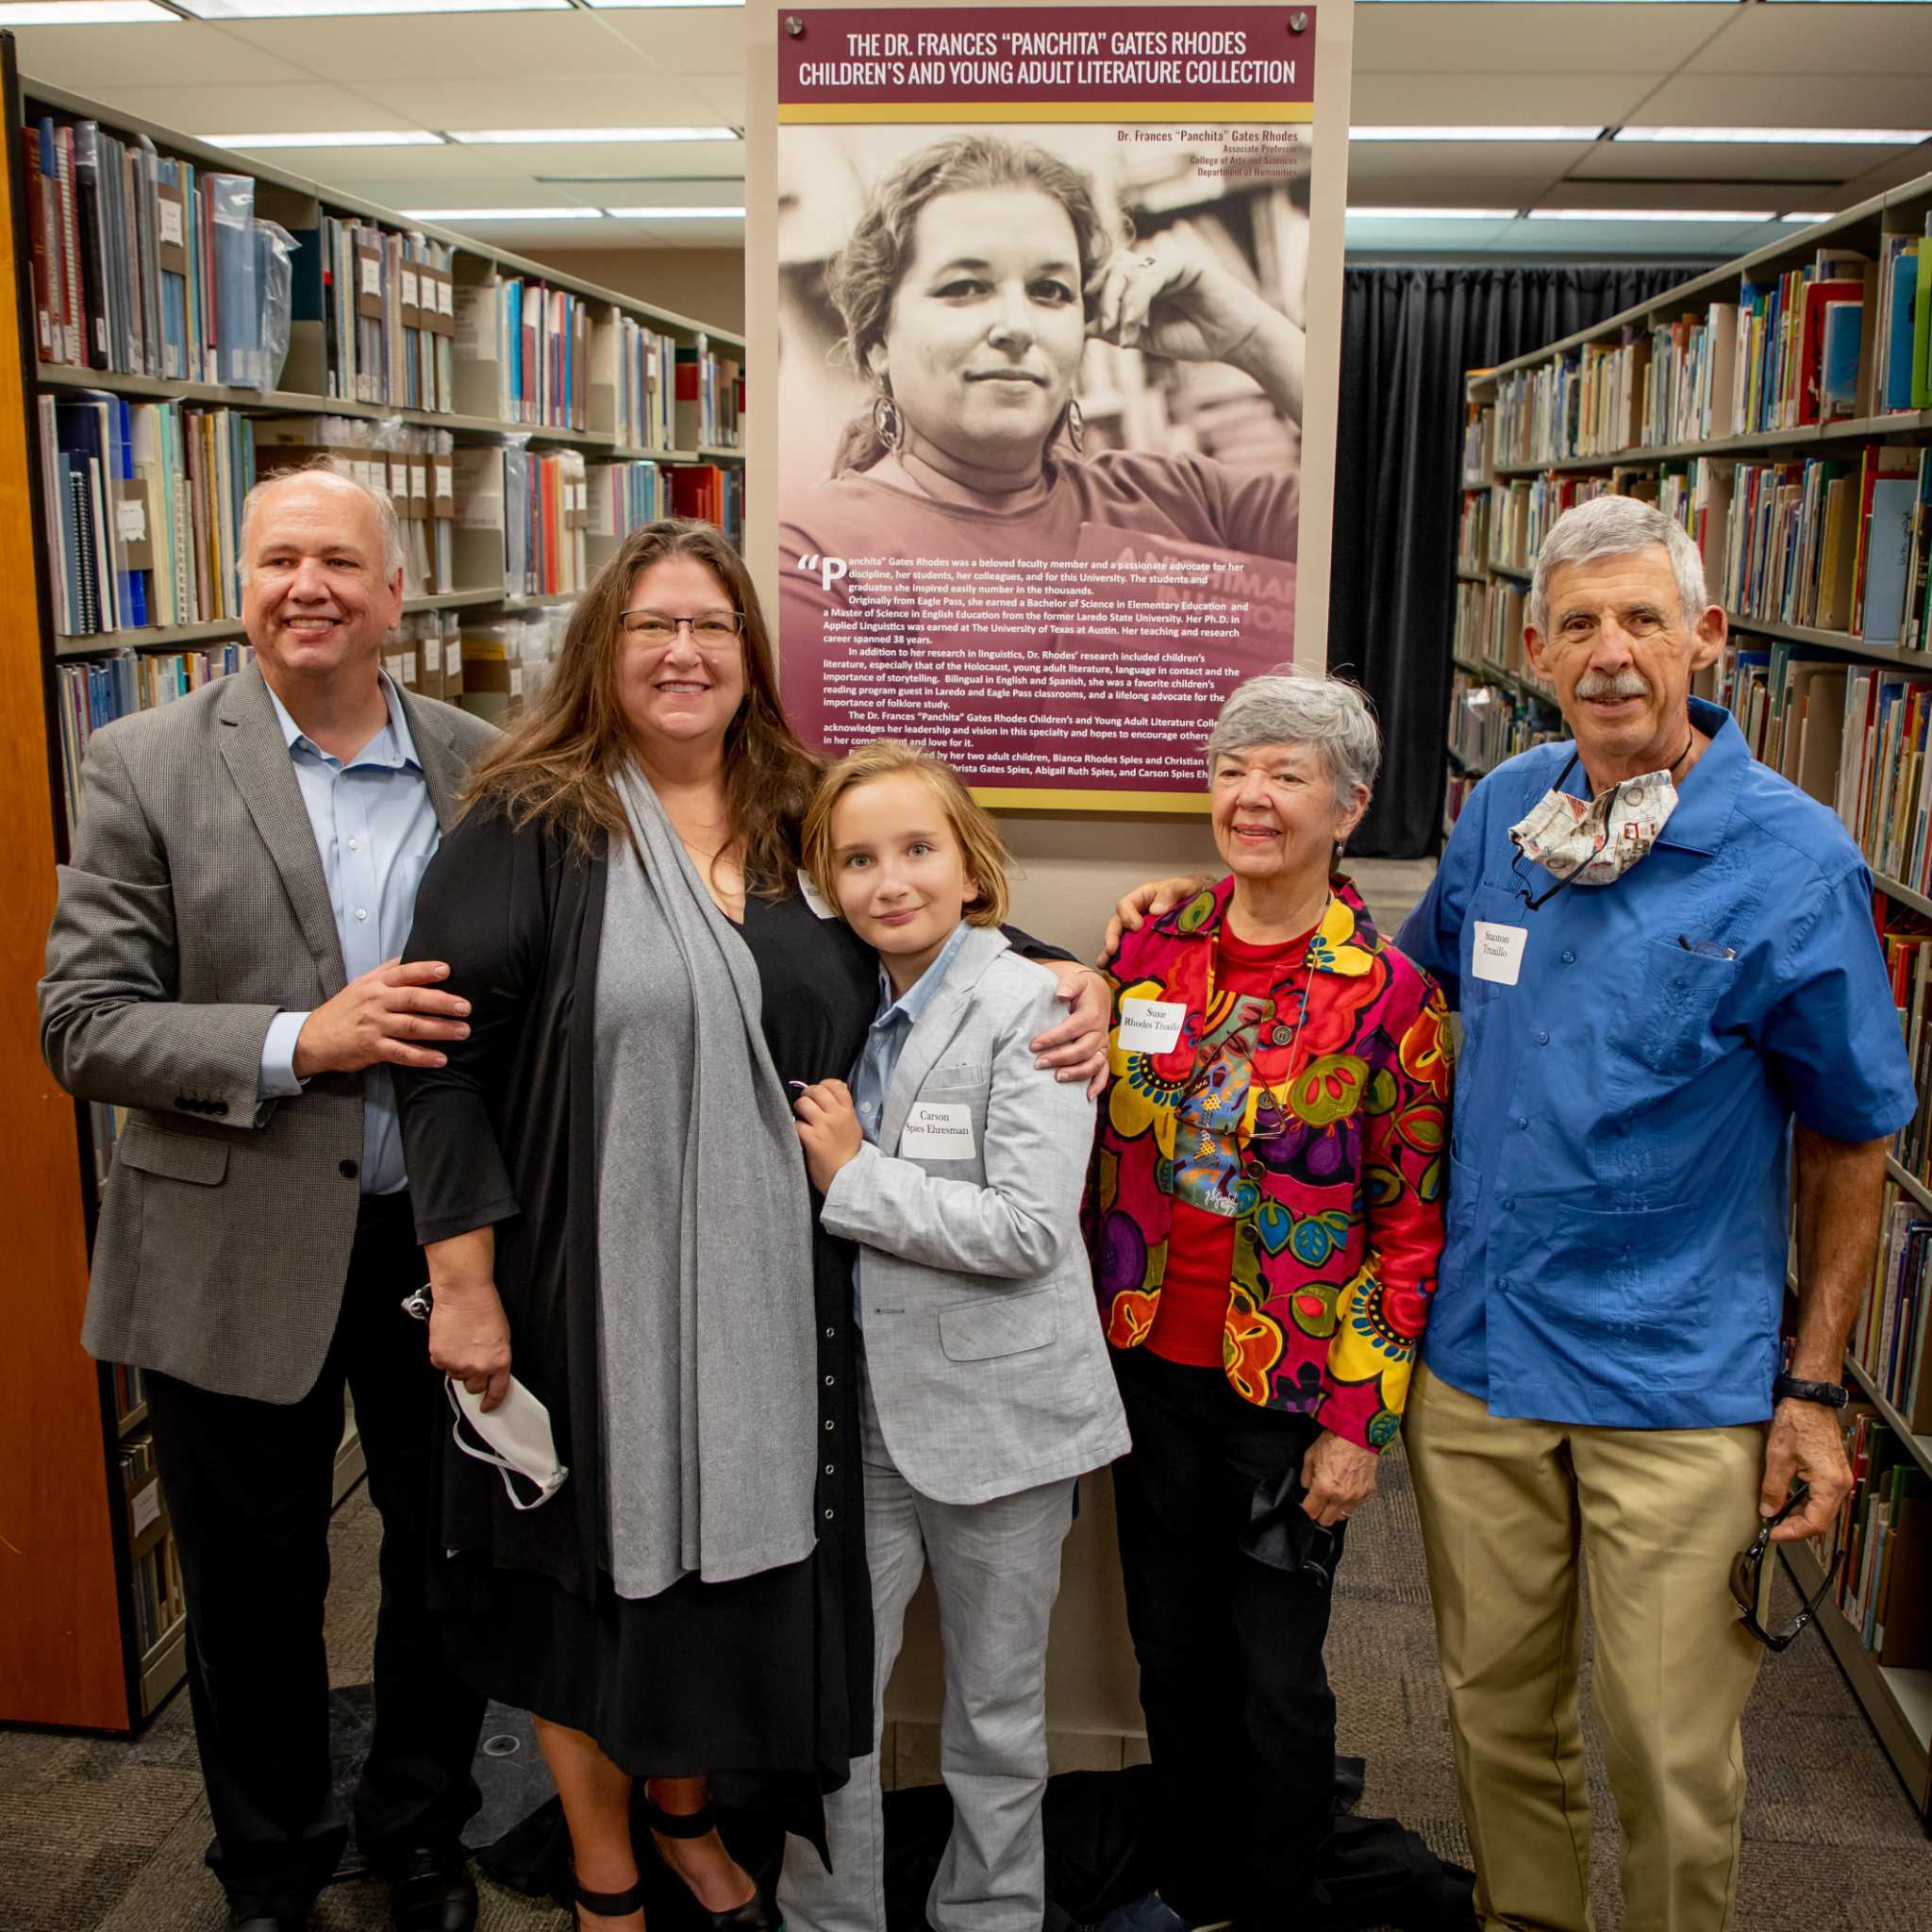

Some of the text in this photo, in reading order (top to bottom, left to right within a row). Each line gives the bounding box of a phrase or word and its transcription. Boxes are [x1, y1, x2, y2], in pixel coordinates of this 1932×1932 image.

[847, 31, 1246, 57] THE DR. FRANCES “PANCHITA” GATES RHODES
[799, 60, 1295, 86] CHILDREN’S AND YOUNG ADULT LITERATURE COLLECTION
[1118, 130, 1131, 142] Dr.
[1135, 130, 1172, 142] Frances
[1232, 130, 1259, 142] Gates
[1262, 130, 1298, 142] Rhodes
[889, 557, 914, 567] Gates
[916, 558, 950, 567] Rhodes
[979, 558, 1015, 568] beloved
[1017, 558, 1049, 570] faculty
[1050, 559, 1089, 569] member
[1091, 559, 1108, 570] and
[1117, 560, 1168, 572] passionate
[1170, 560, 1211, 571] advocate
[1212, 561, 1226, 571] for
[1228, 561, 1244, 572] her
[848, 582, 1094, 594] graduates she inspired easily number in the thousands.
[848, 594, 891, 606] Originally
[893, 595, 915, 605] from
[918, 595, 941, 607] Eagle
[943, 596, 966, 607] Pass,
[967, 596, 984, 607] she
[986, 597, 1018, 607] earned
[1027, 597, 1068, 608] Bachelor
[1069, 598, 1079, 608] of
[1080, 598, 1115, 608] Science
[1116, 599, 1125, 608] in
[1127, 599, 1180, 611] Elementary
[1181, 600, 1226, 610] Education
[1231, 601, 1249, 611] and
[823, 621, 1240, 638] Applied Linguistics was earned at The University of Texas at Austin. Her teaching and research
[854, 633, 891, 644] spanned
[893, 634, 905, 643] 38
[907, 636, 933, 645] years.
[848, 646, 858, 656] In
[859, 646, 897, 657] addition
[899, 647, 909, 657] to
[910, 647, 926, 658] her
[927, 648, 966, 658] research
[968, 648, 977, 658] in
[978, 649, 1025, 660] linguistics,
[1027, 650, 1040, 659] Dr.
[1080, 651, 1119, 661] research
[1121, 652, 1160, 661] included
[823, 672, 874, 683] importance
[876, 673, 887, 682] of
[888, 673, 941, 685] storytelling.
[944, 674, 984, 686] Bilingual
[985, 675, 994, 684] in
[996, 675, 1028, 687] English
[1029, 675, 1047, 686] and
[1049, 676, 1087, 688] Spanish,
[1089, 676, 1105, 687] she
[1134, 677, 1170, 688] favorite
[823, 697, 950, 709] importance of folklore study.
[848, 709, 866, 719] The
[867, 710, 880, 720] Dr.
[882, 710, 915, 721] Frances
[967, 712, 992, 722] Gates
[994, 712, 1028, 723] Rhodes
[1075, 714, 1092, 724] and
[1094, 715, 1123, 726] Young
[1124, 715, 1149, 725] Adult
[1151, 716, 1195, 726] Literature
[823, 722, 1209, 741] acknowledges her leadership and vision in this specialty and hopes to encourage others
[834, 735, 849, 744] her
[910, 736, 926, 746] and
[928, 737, 948, 746] love
[949, 737, 963, 746] for
[964, 737, 974, 746] it.
[1146, 1007, 1167, 1018] Susie
[1124, 1017, 1152, 1028] Rhodes
[920, 1110, 950, 1122] Carson
[926, 1124, 969, 1135] Ehresman
